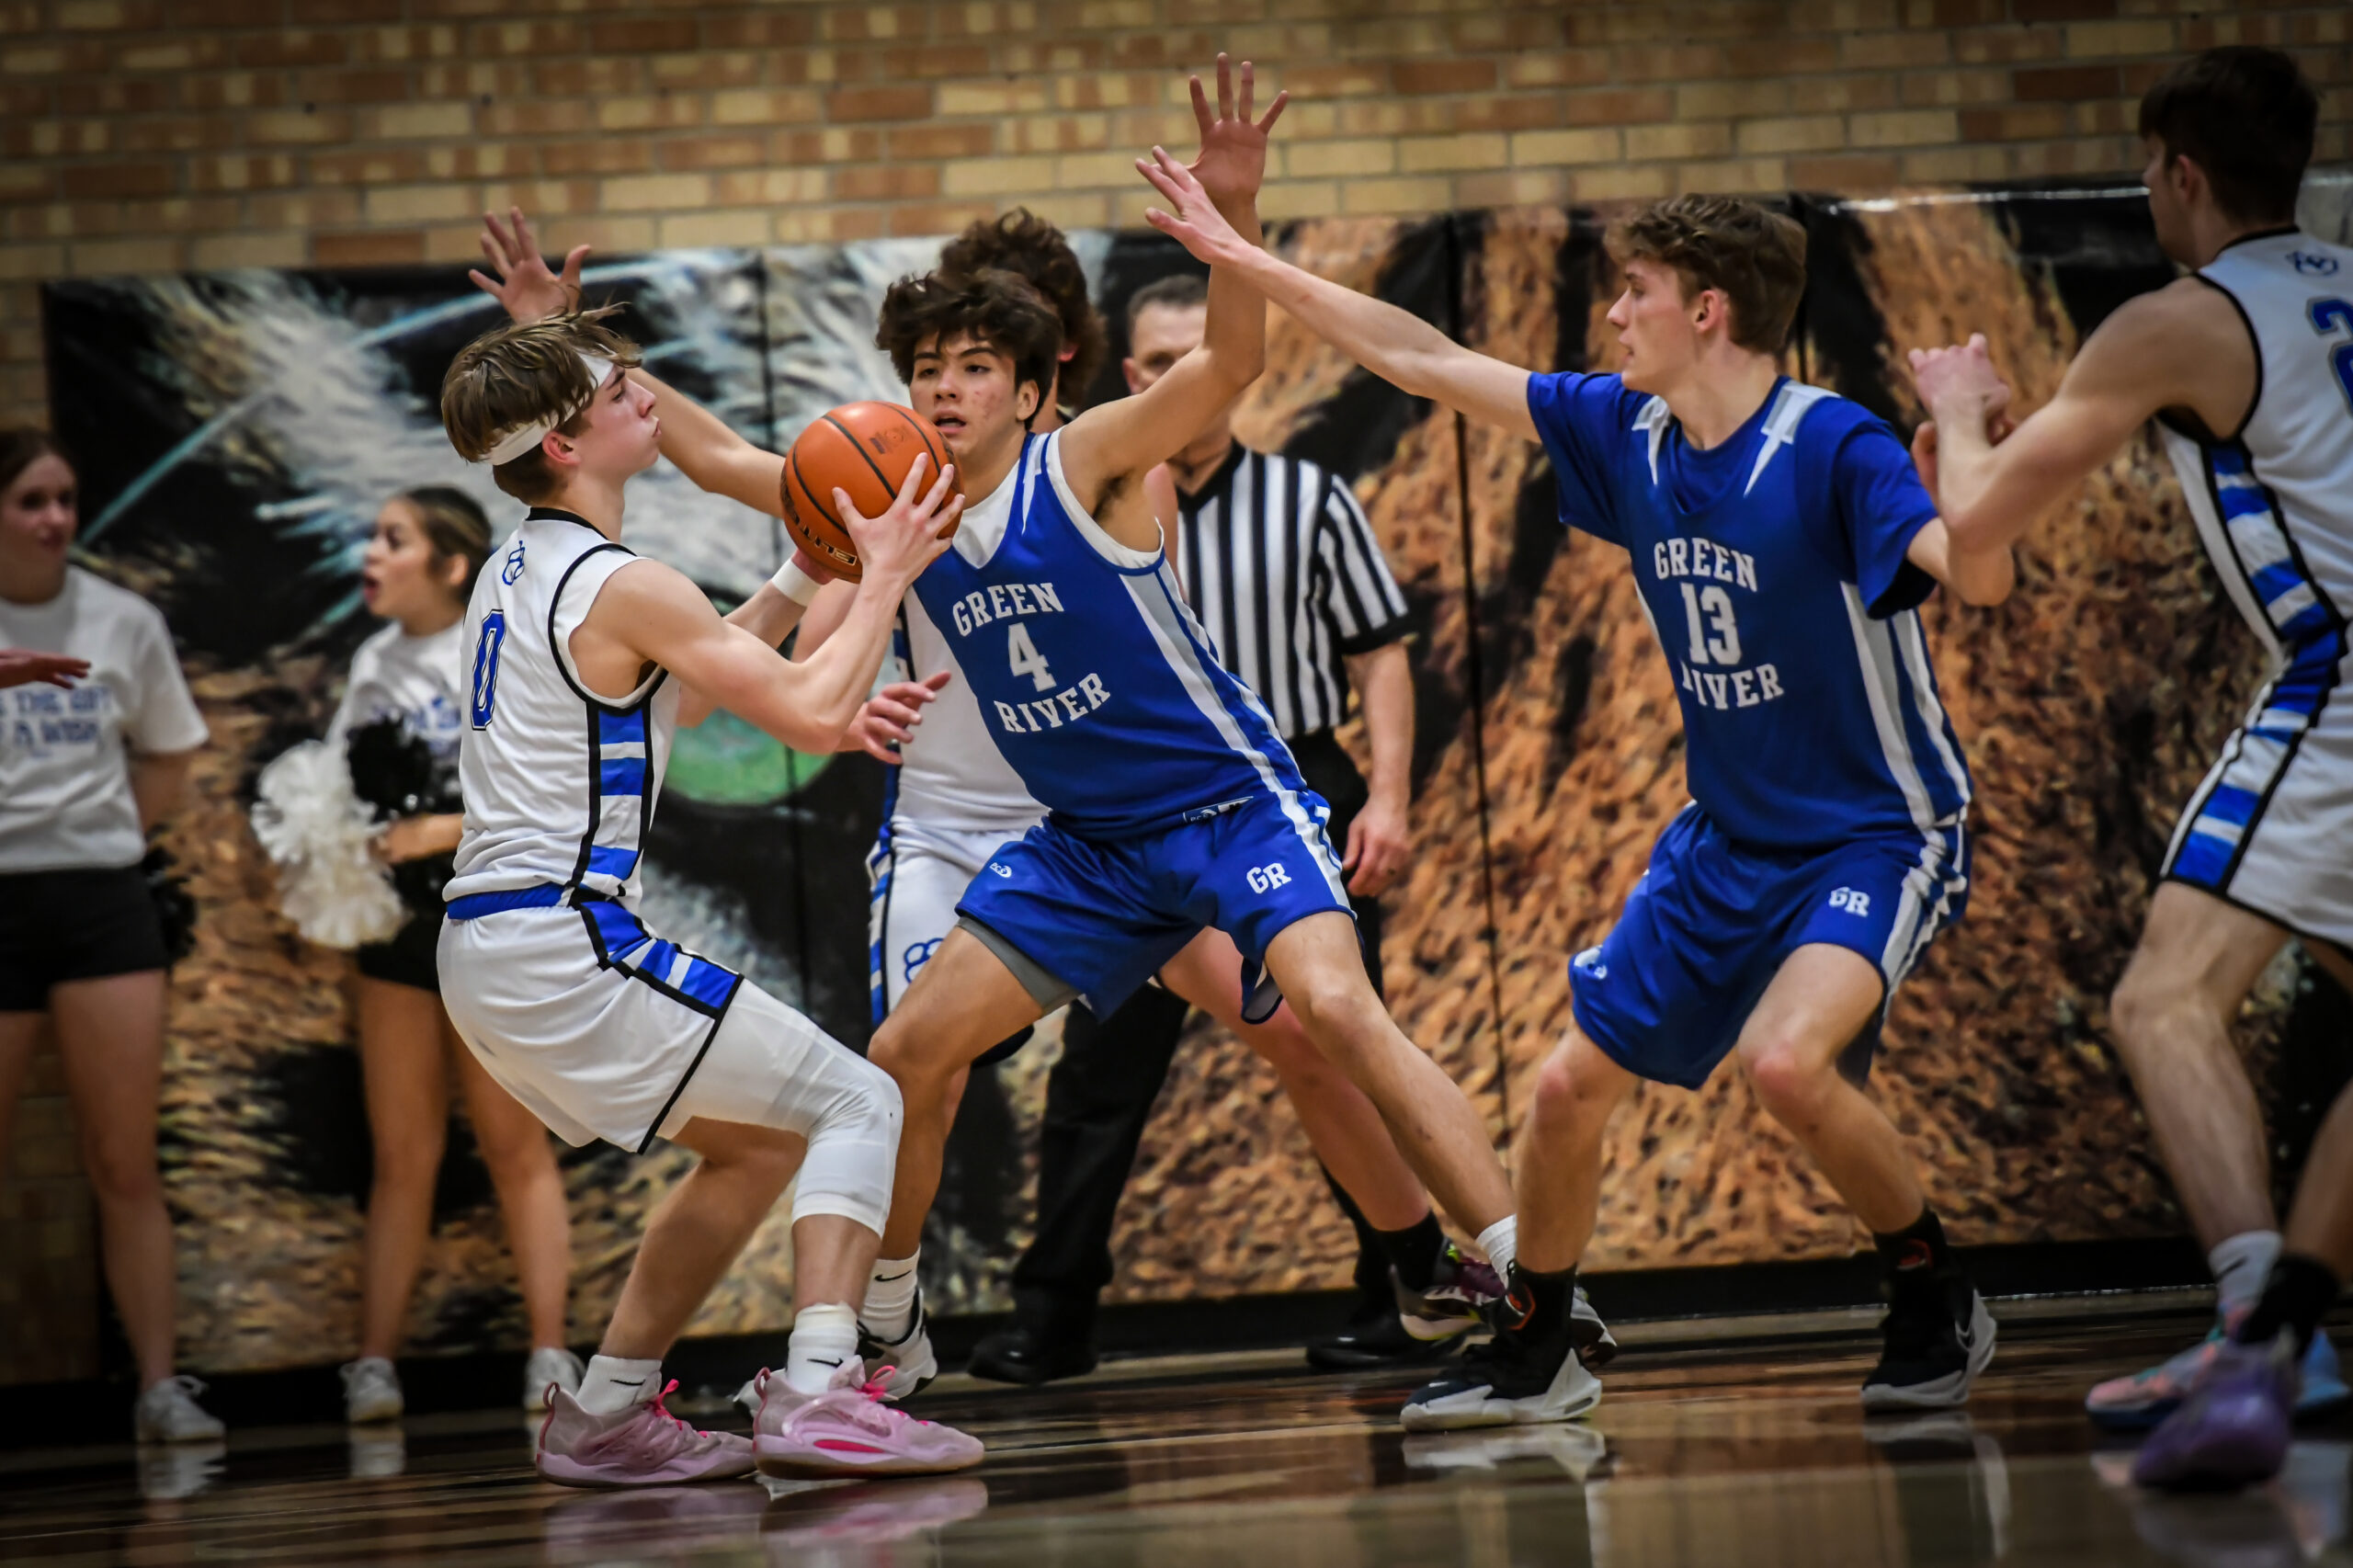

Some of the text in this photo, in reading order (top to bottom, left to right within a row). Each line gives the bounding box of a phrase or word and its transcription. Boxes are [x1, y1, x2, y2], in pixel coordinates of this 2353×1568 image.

[1654, 538, 1757, 593] GREEN
[952, 582, 1064, 637] GREEN
[1679, 581, 1743, 665] 13
[471, 608, 506, 731] 0
[1007, 621, 1057, 692] 4
[993, 673, 1111, 733] RIVER
[1246, 862, 1292, 894] GR
[1828, 886, 1870, 917] GR
